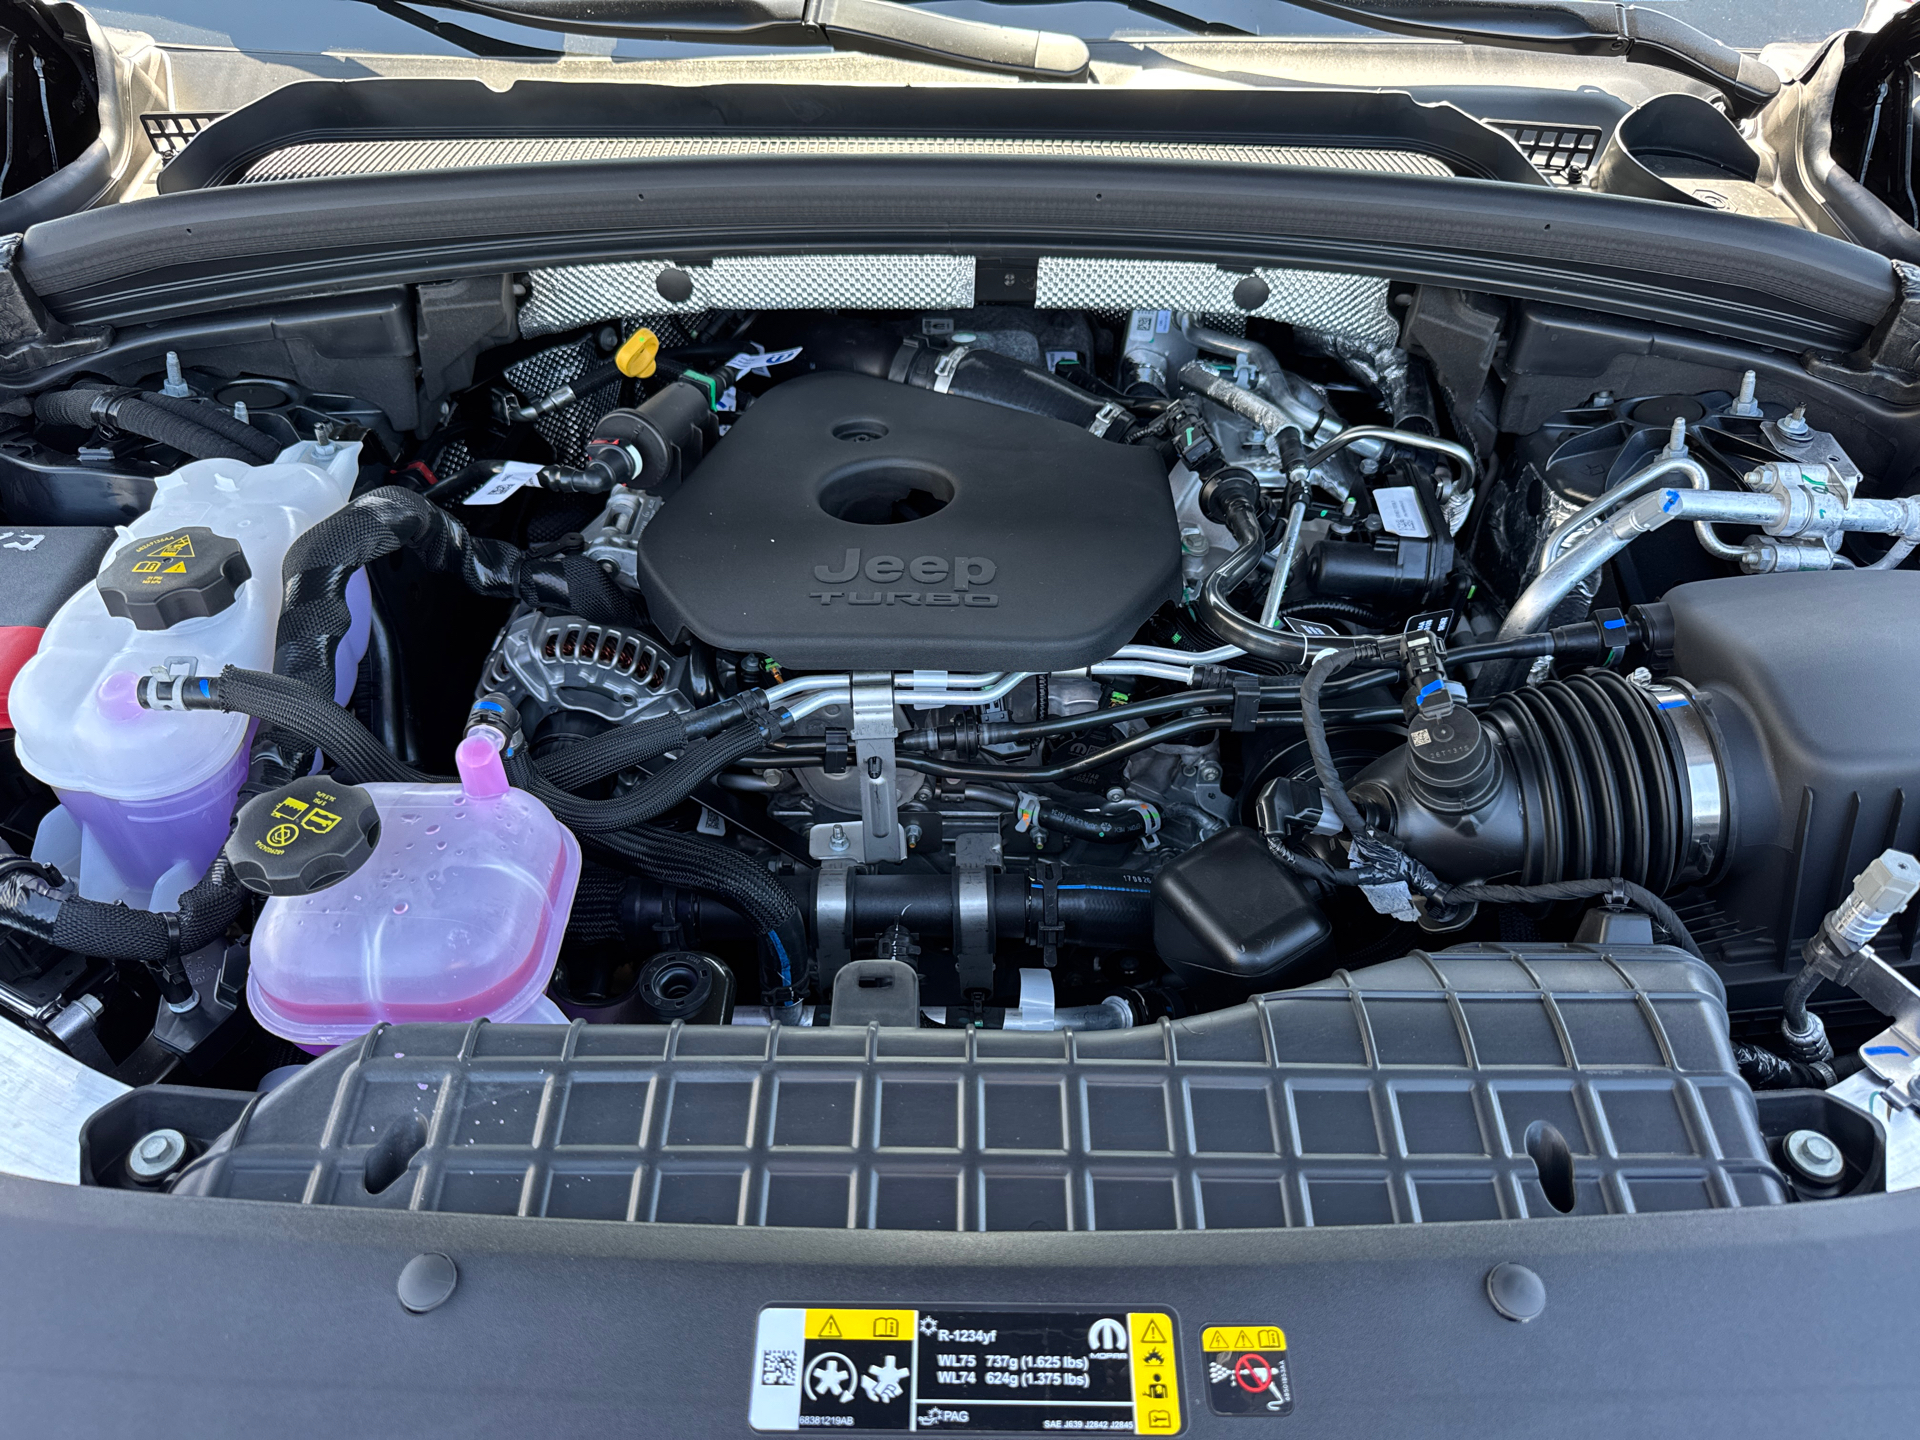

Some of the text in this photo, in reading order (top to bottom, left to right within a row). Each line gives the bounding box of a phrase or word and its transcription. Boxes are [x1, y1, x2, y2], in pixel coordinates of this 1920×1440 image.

[814, 548, 996, 591] Jeep
[809, 592, 998, 607] TURBO
[937, 1329, 997, 1345] R-1234yf
[936, 1354, 1090, 1371] WL75 737g (1.625 lbs)
[1089, 1352, 1128, 1360] MOPAR
[936, 1371, 1091, 1389] WL74 624g (1.375 lbs)
[799, 1416, 854, 1426] 68381219AB
[944, 1410, 969, 1422] PAG
[1044, 1420, 1134, 1429] SAE J639 J2842 J2845
